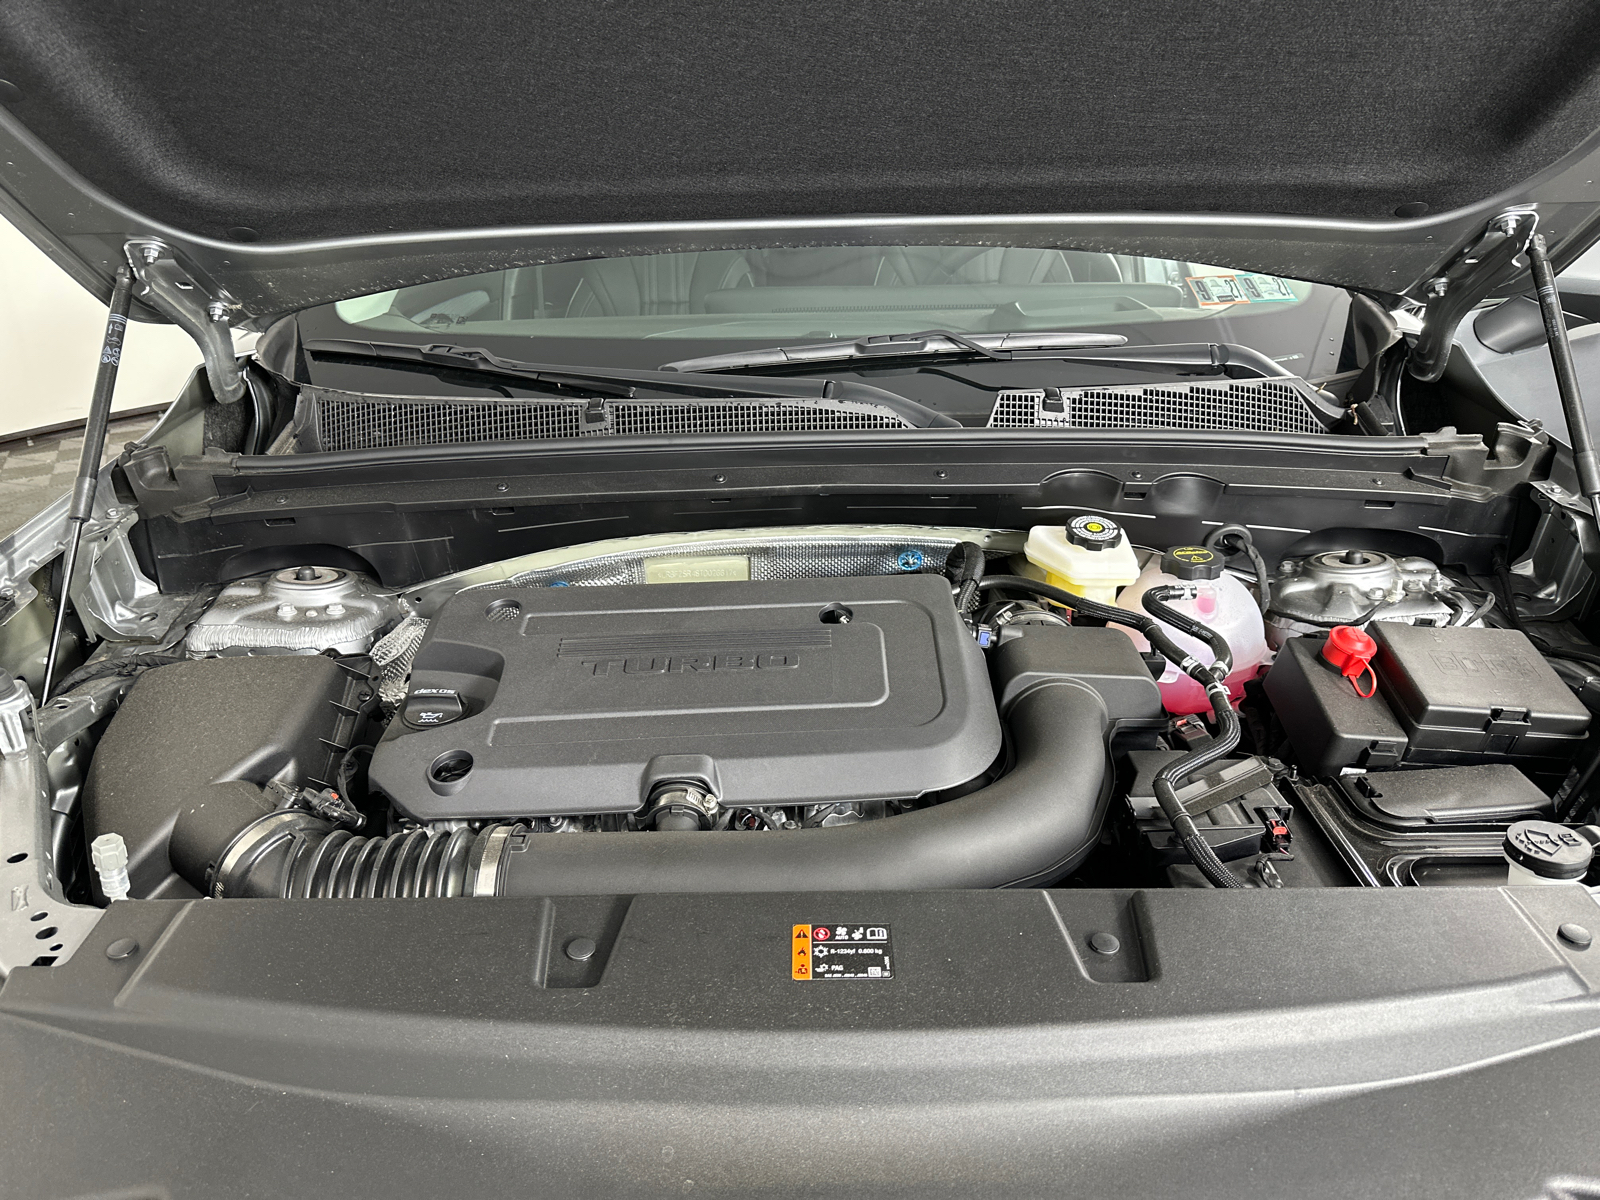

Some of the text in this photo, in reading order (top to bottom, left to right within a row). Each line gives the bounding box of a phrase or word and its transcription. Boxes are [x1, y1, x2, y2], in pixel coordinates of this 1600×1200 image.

[1195, 279, 1243, 300] 9 27
[1243, 277, 1290, 298] 9 27
[581, 654, 800, 677] TURBO
